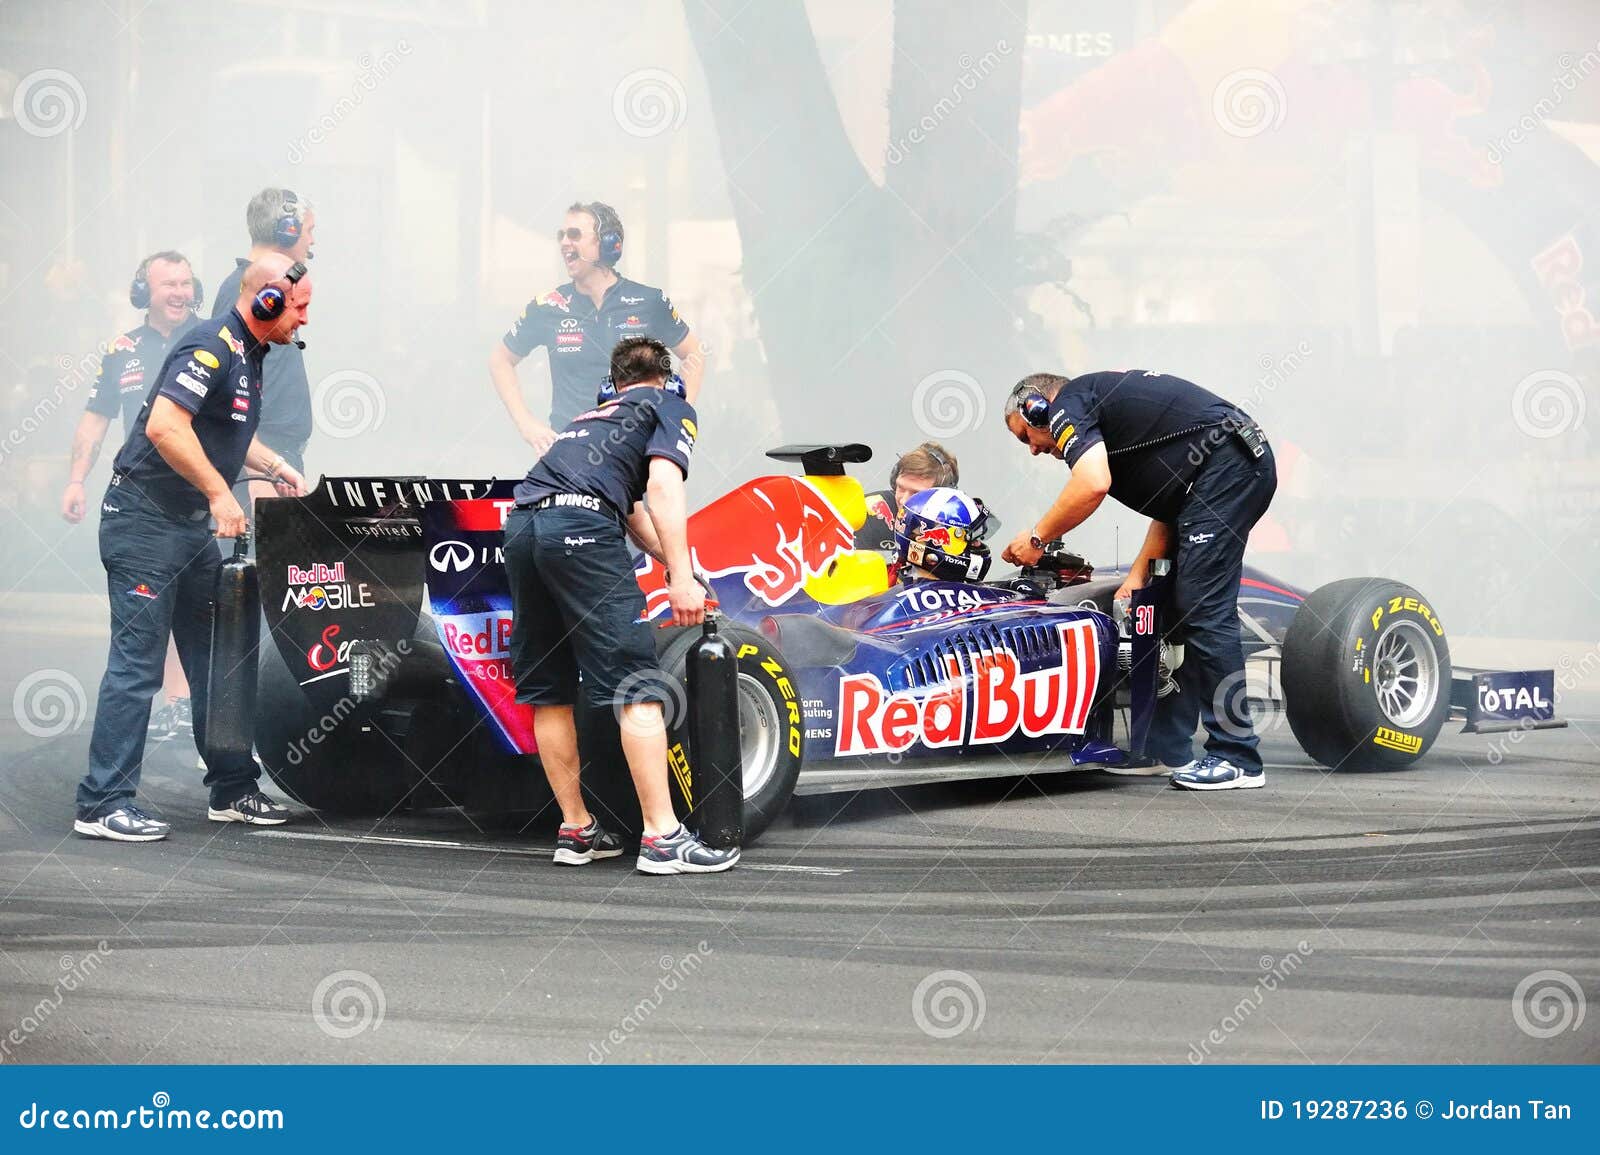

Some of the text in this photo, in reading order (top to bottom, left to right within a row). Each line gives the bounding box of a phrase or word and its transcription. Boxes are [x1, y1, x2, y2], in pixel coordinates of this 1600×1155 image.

[555, 493, 601, 511] WINGS
[345, 523, 411, 537] Inspired
[287, 562, 345, 585] Red Bull
[944, 554, 968, 566] TOTAL
[282, 584, 376, 612] MOBILE
[896, 587, 997, 612] TOTAL
[1136, 605, 1154, 635] 31
[1372, 596, 1444, 636] P ZERO
[443, 618, 492, 655] Red
[475, 664, 515, 680] COL
[737, 643, 758, 658] P
[761, 656, 800, 758] ZERO
[835, 653, 965, 756] Red
[970, 619, 1101, 745] Bull
[1478, 685, 1548, 712] TOTAL
[1374, 726, 1423, 754] PIRELLI
